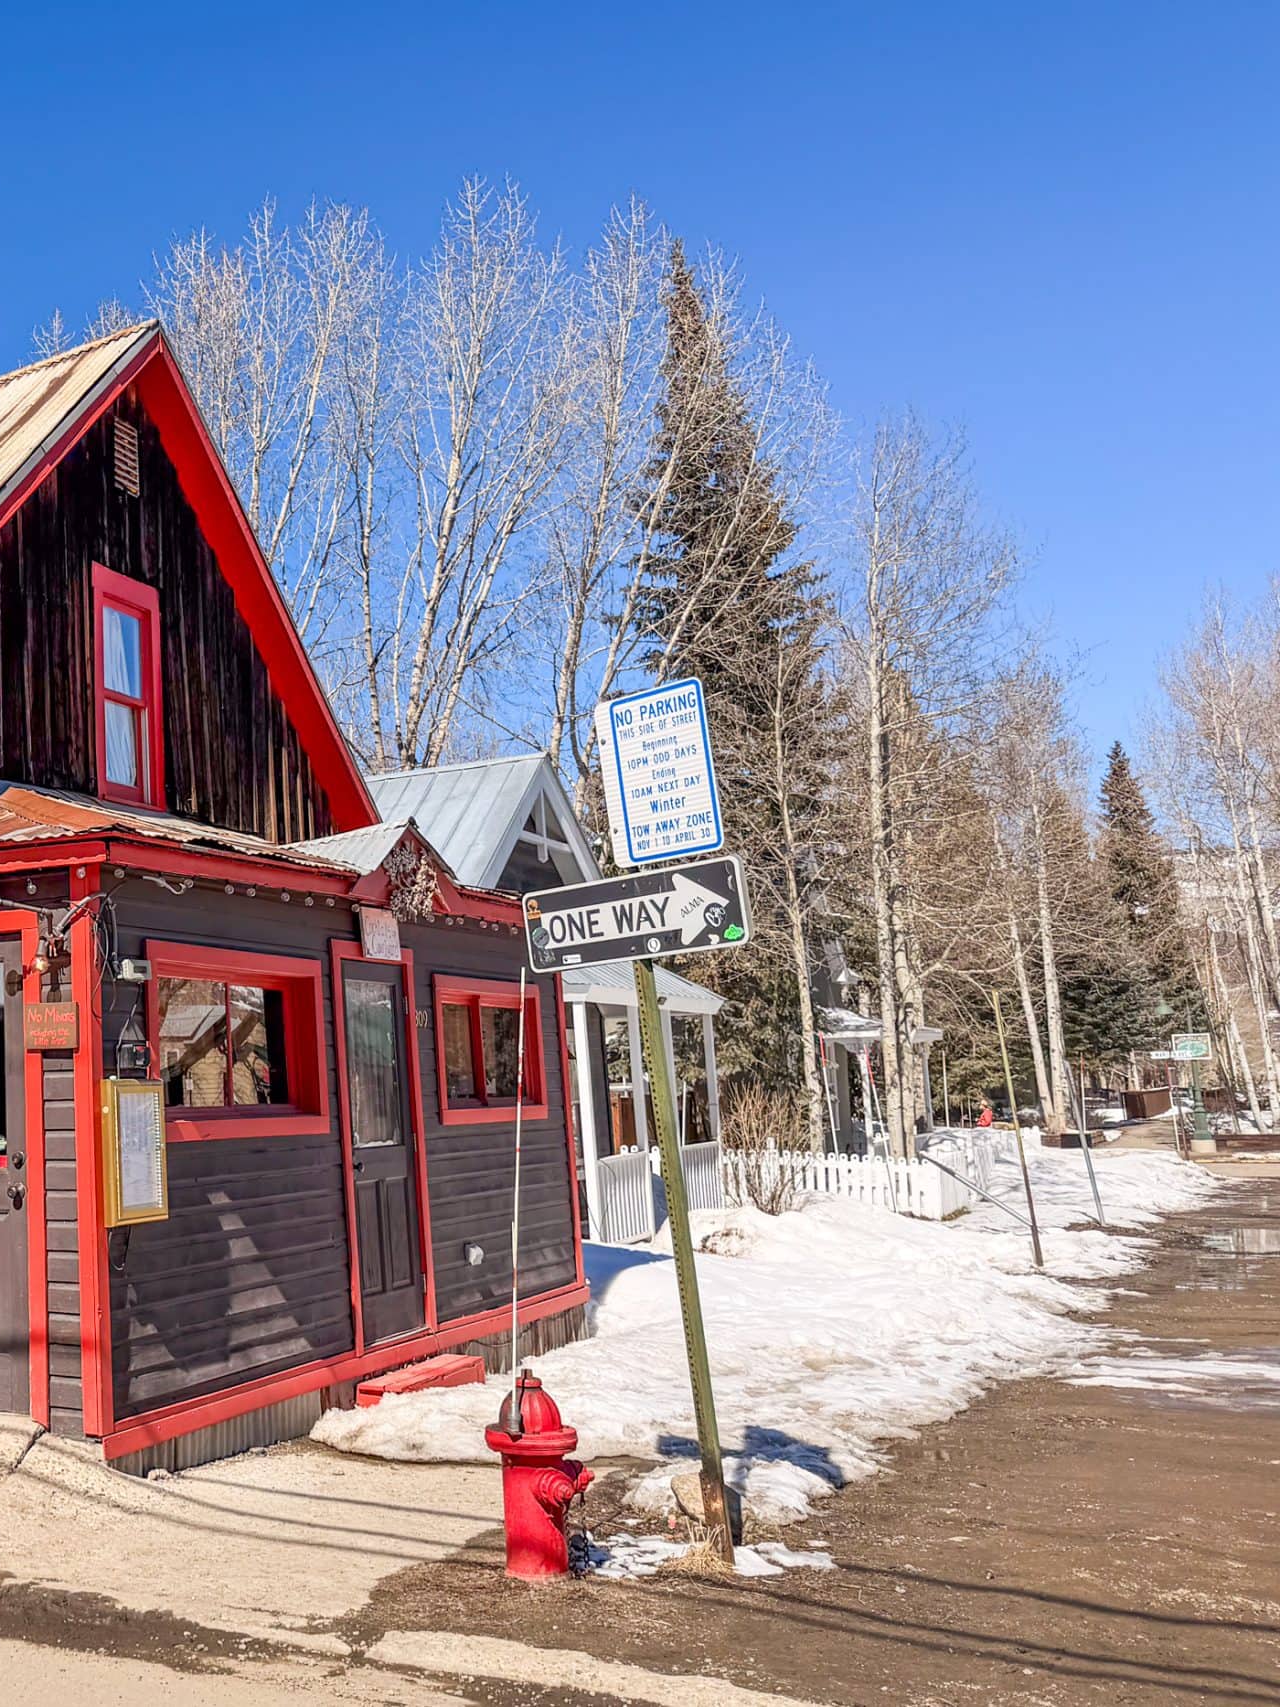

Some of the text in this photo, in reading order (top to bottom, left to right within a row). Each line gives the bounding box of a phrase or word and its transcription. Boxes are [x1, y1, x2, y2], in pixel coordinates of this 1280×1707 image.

[615, 691, 697, 728] NO PARKING
[619, 711, 697, 741] THIS SIDE OF STREET
[642, 736, 678, 751] Beginning
[627, 745, 697, 770] 10PM ODD DAYS
[652, 767, 676, 780] Ending
[631, 775, 701, 799] 10AM NEXT DAY
[649, 796, 686, 814] Winter
[632, 811, 712, 838] TOW AWAY ZONE
[637, 837, 650, 851] NOV
[662, 834, 670, 845] TO
[675, 830, 695, 843] APRIL
[701, 827, 711, 838] 30
[680, 895, 705, 918] ALMA
[549, 908, 604, 943] ONE
[612, 896, 670, 934] WAY
[27, 1008, 42, 1024] No
